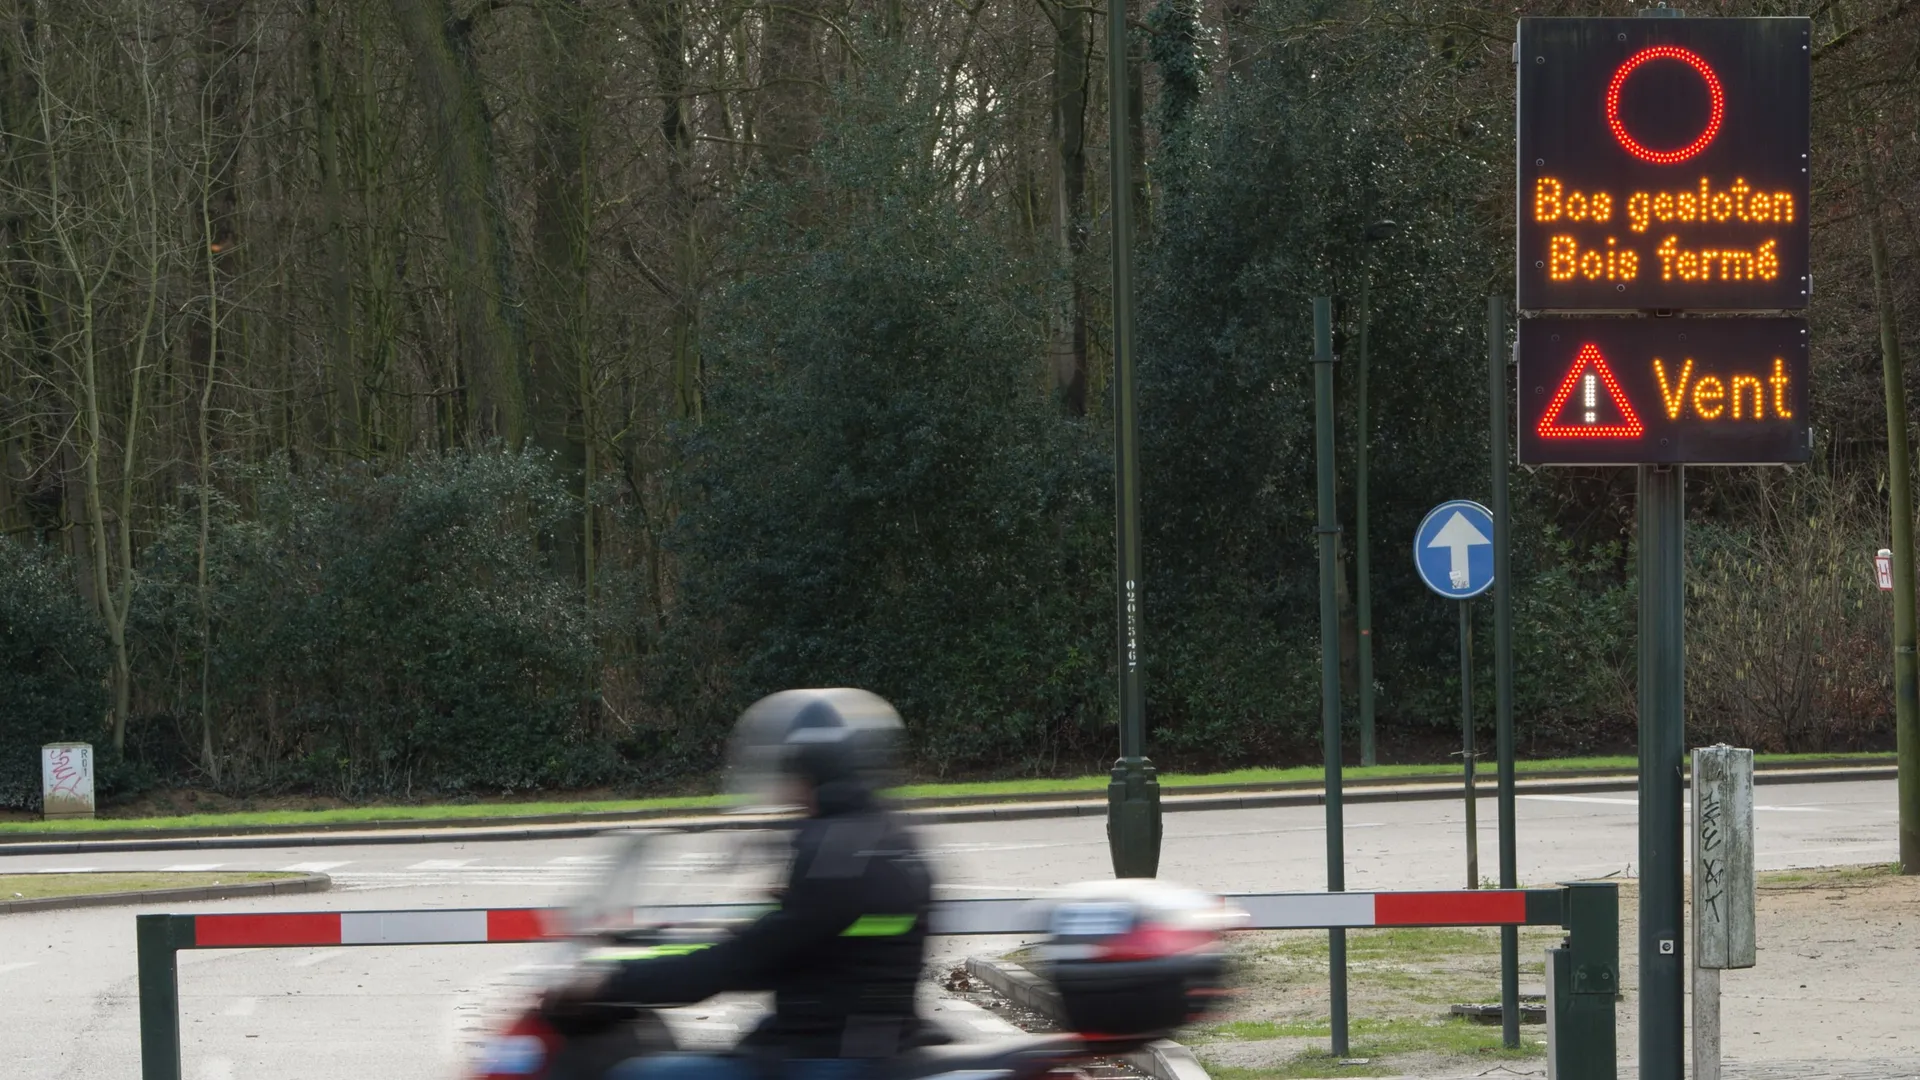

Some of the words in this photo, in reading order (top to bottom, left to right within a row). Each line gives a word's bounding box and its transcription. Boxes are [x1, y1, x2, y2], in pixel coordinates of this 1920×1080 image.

[1535, 177, 1612, 222] Bos
[1627, 177, 1794, 232] gesloten
[1550, 235, 1639, 281] Bois
[1656, 234, 1778, 281] fermé
[1653, 358, 1792, 420] Vent
[1878, 563, 1890, 585] H
[80, 749, 88, 777] R01
